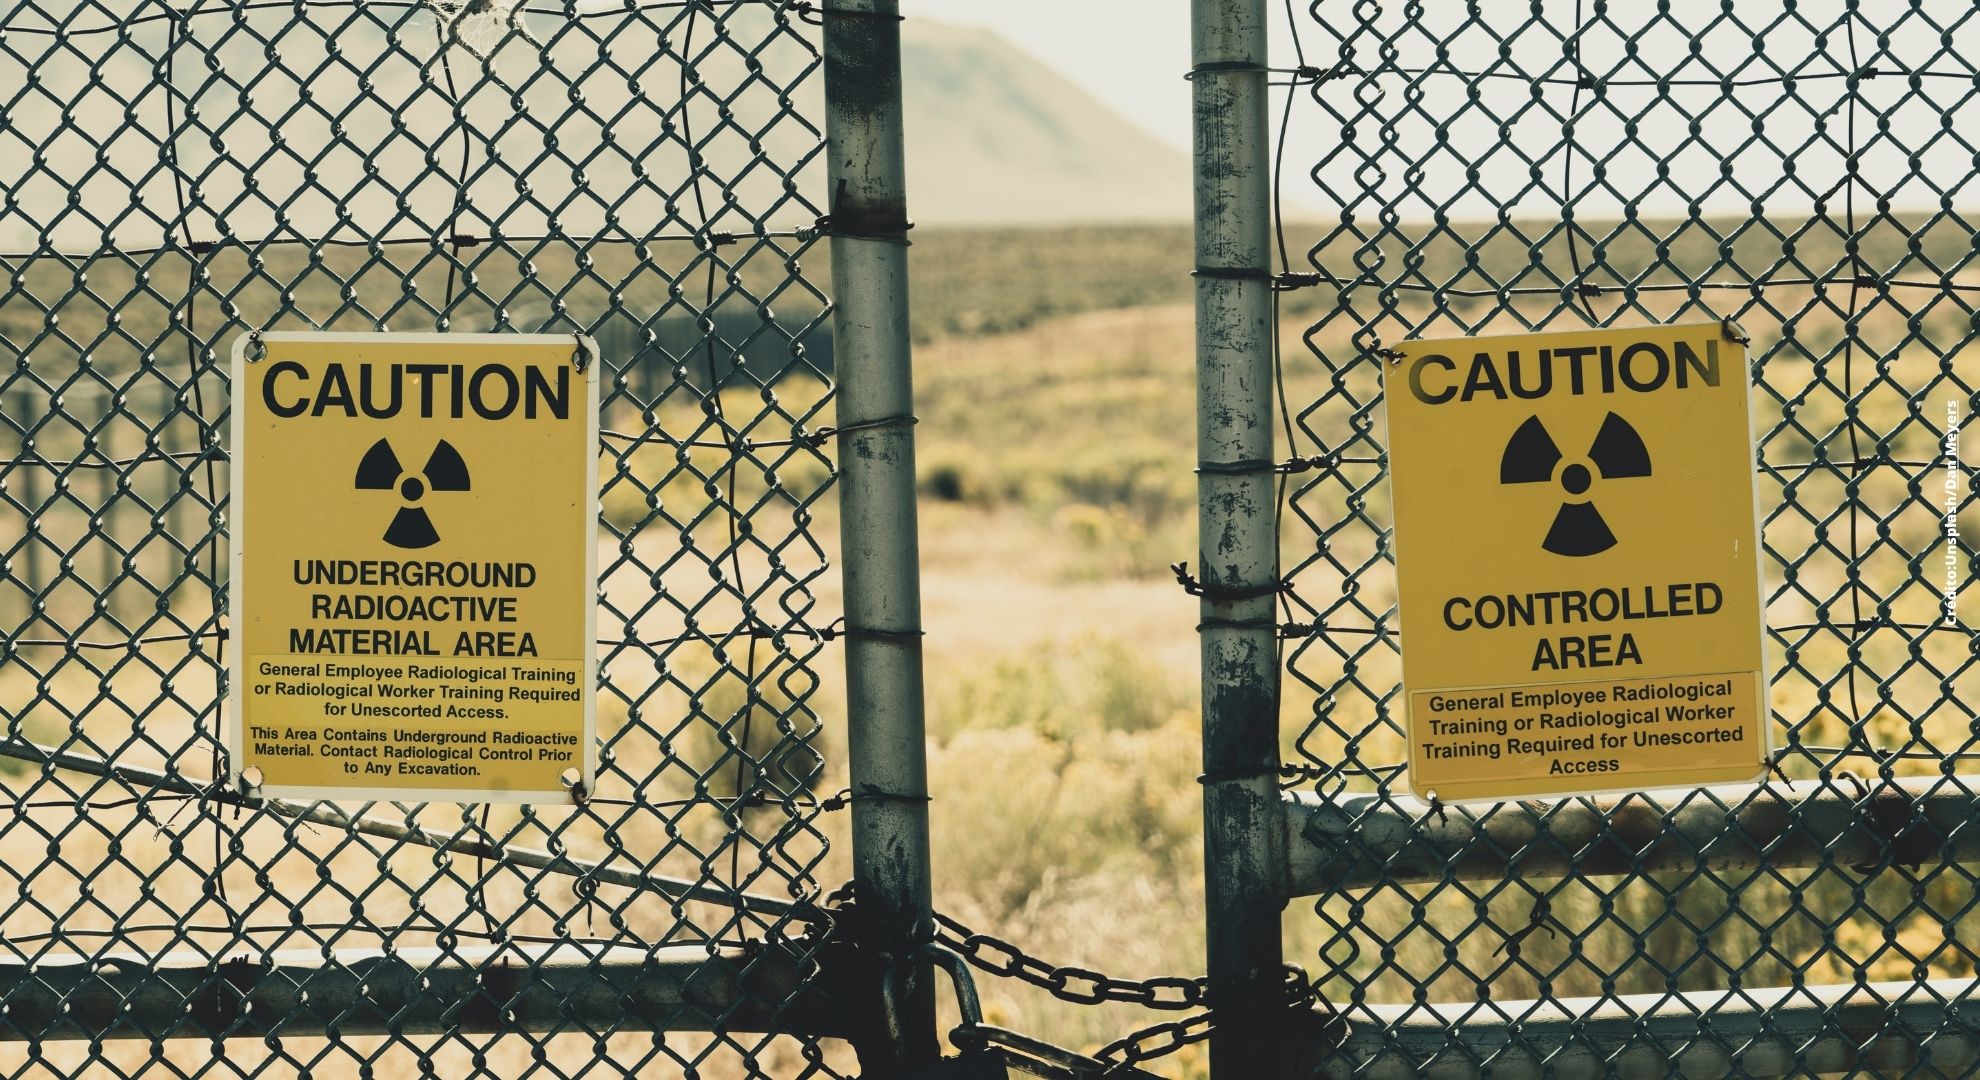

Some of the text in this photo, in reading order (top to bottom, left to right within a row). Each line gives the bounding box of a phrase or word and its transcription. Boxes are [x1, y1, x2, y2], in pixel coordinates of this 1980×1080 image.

[1408, 340, 1720, 404] CAUTION
[262, 361, 569, 420] CAUTION
[293, 560, 536, 588] UNDERGROUND
[312, 595, 517, 622] RADIOACTIVE
[1443, 582, 1723, 631] CONTROLLED
[289, 629, 538, 657] MATERIAL AREA
[1531, 633, 1643, 671] AREA
[259, 662, 576, 684] General Employee Radiological Training
[254, 682, 580, 702] or Radiological Worker Training Required
[1430, 680, 1732, 712] General Employee Radiological
[324, 703, 508, 719] for Unescorted Access.
[1429, 705, 1735, 737] Training or Radiological Worker
[250, 727, 578, 747] This Area Contains Underground Radioactive
[1422, 726, 1744, 760] Training Required for Unescorted
[254, 743, 572, 762] Material. Contact Radiological Control Prior
[1549, 757, 1620, 775] Access
[344, 762, 480, 777] to Any Excavation.
